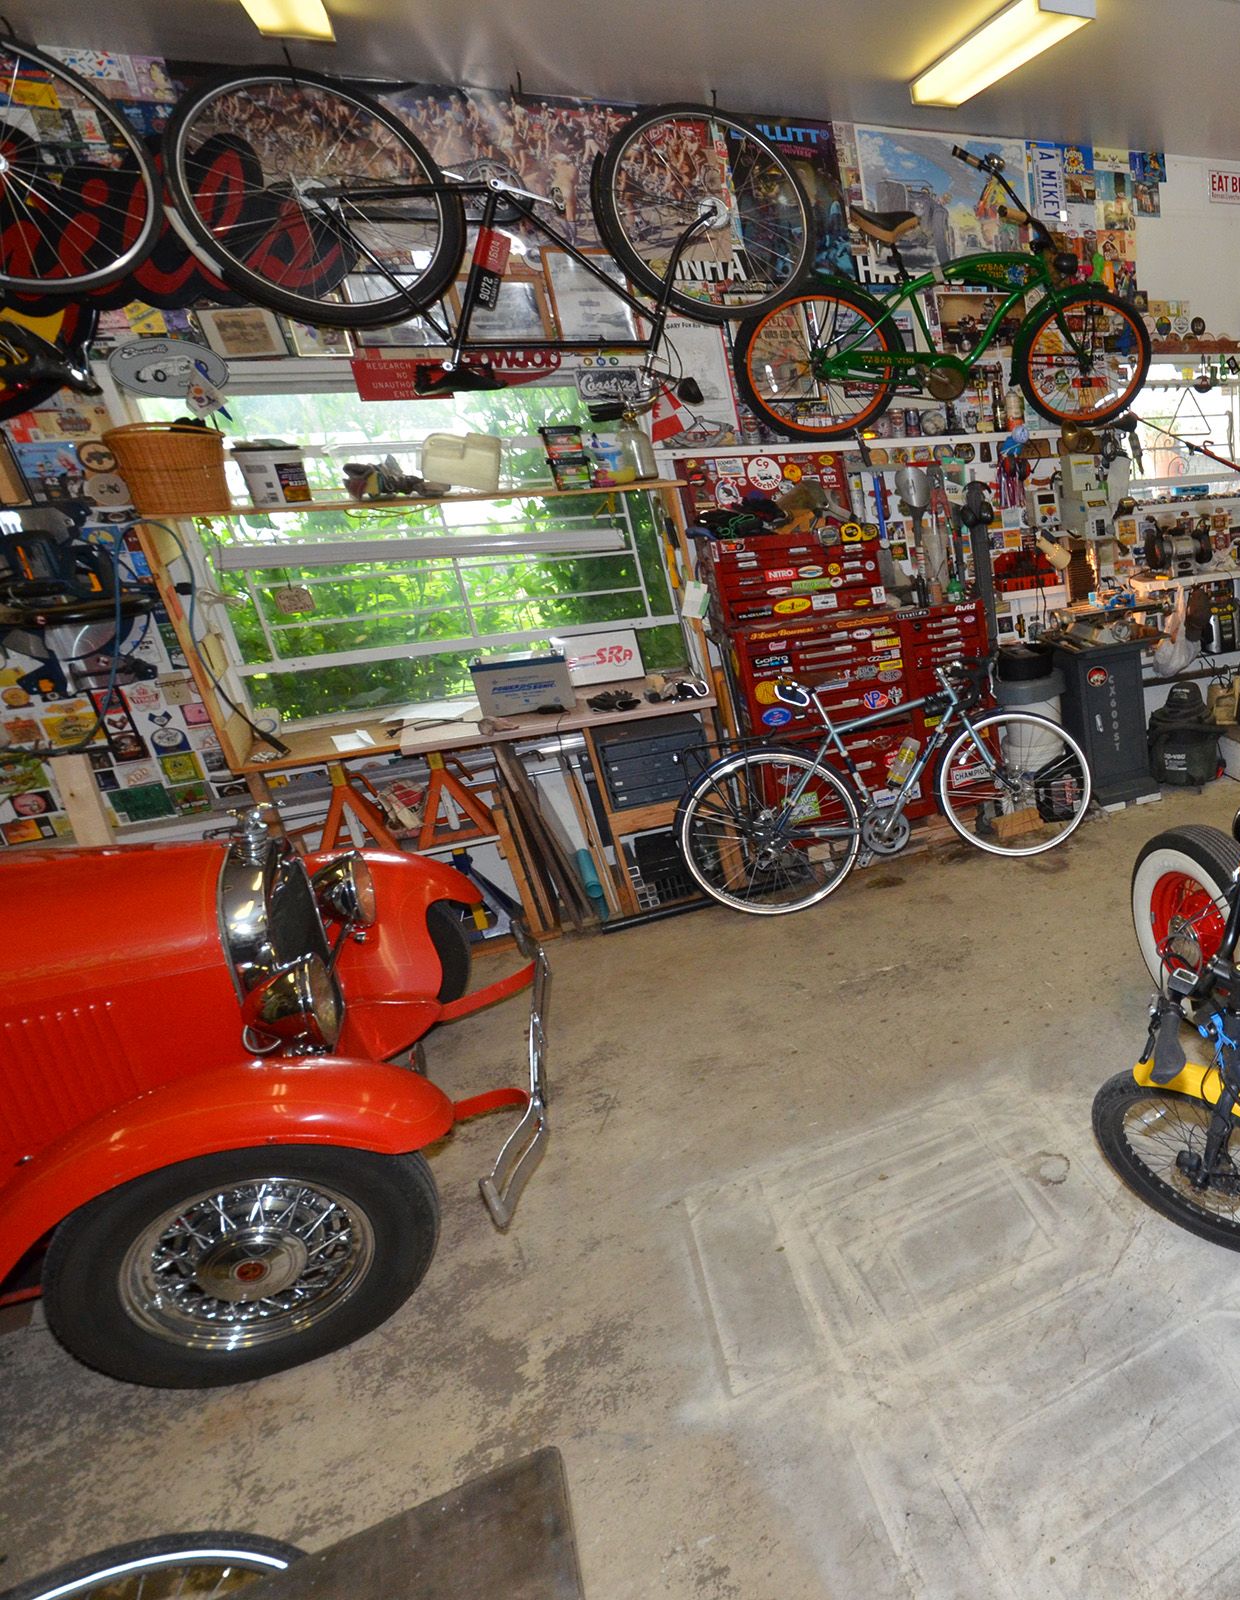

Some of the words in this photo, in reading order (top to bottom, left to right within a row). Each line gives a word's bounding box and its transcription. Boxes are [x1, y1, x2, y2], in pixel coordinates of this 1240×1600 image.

[1211, 175, 1229, 192] EAT
[1039, 168, 1062, 220] MIKEY
[479, 276, 494, 301] 9072
[366, 362, 412, 371] RESEARCH
[396, 371, 409, 380] NO
[372, 380, 416, 391] UNAUTHOR
[755, 458, 769, 470] C9
[750, 473, 781, 491] Machine
[767, 569, 794, 580] NITRO
[874, 587, 883, 598] B
[754, 654, 789, 665] GoPro
[953, 766, 990, 783] CHAMPION
